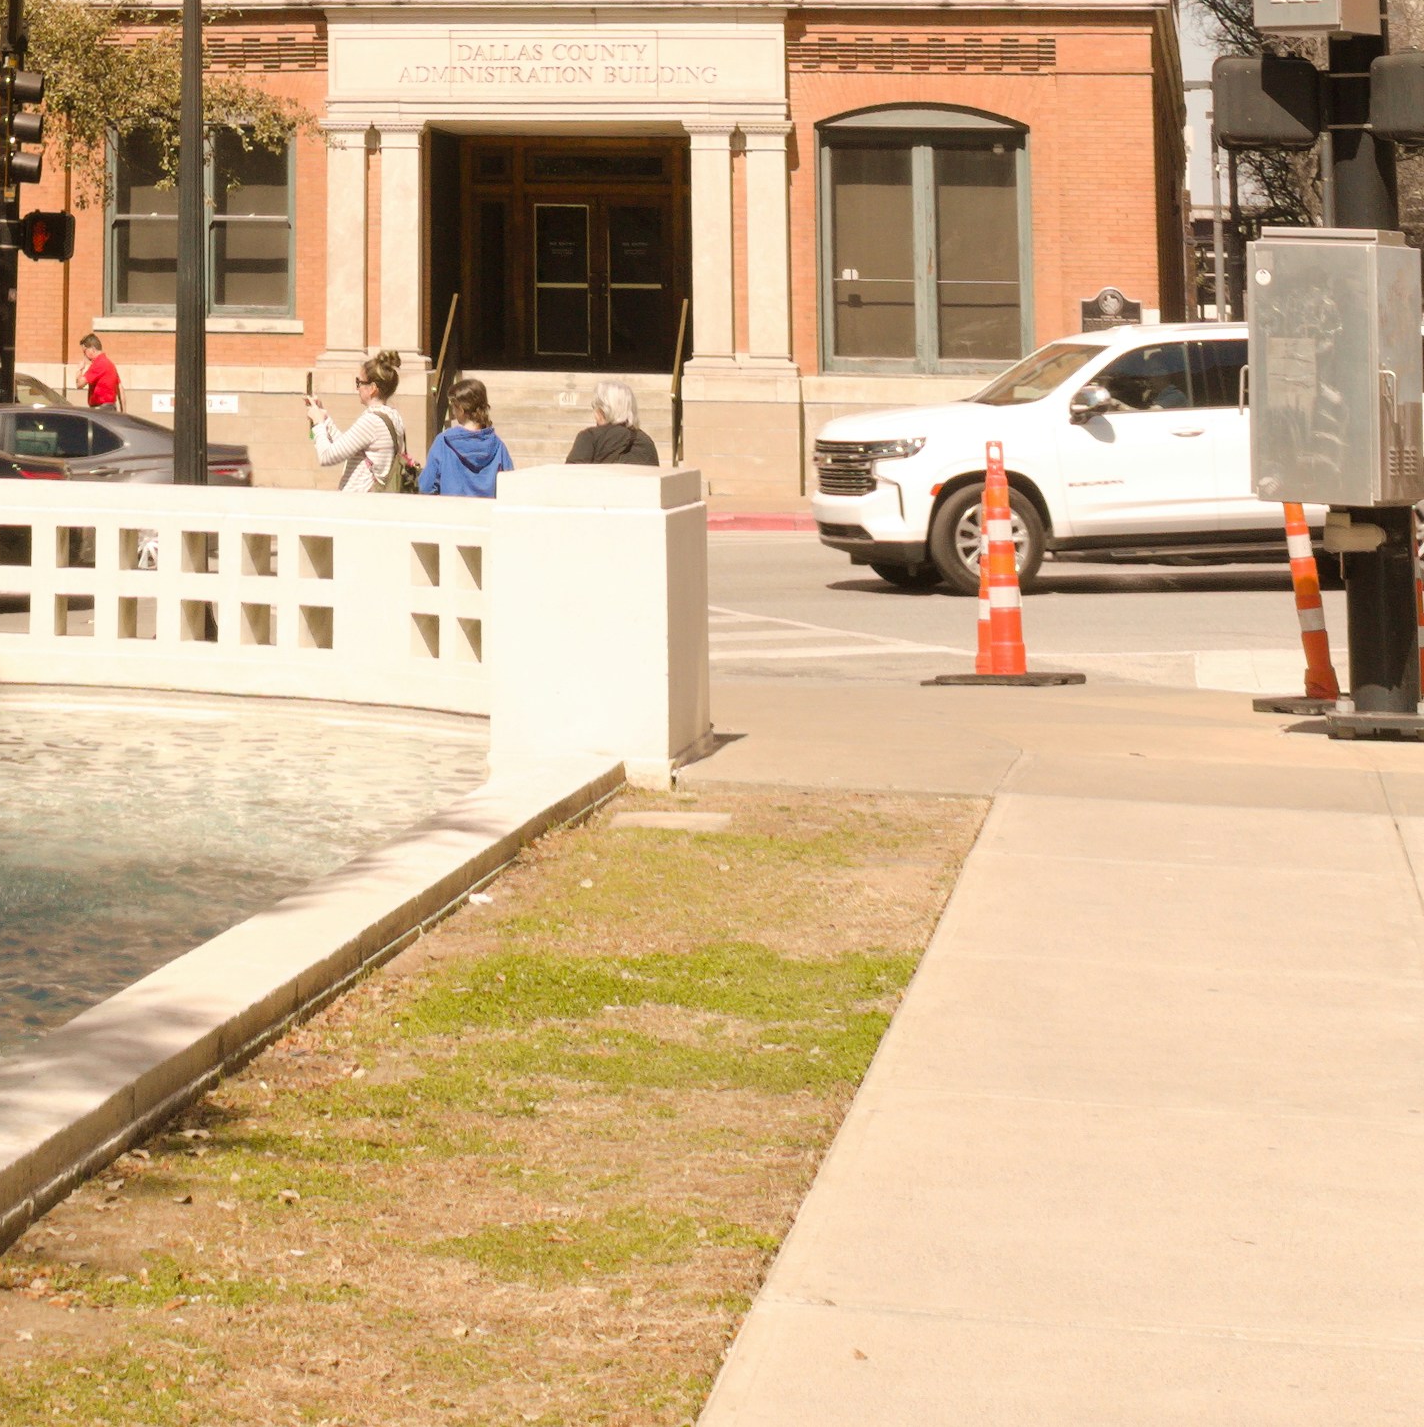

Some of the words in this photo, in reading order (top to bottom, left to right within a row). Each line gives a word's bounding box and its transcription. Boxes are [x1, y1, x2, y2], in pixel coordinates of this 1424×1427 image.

[456, 43, 544, 62] DALLAS
[551, 43, 649, 62] COUNTY
[398, 65, 594, 84] ADMINISTRATION
[603, 65, 719, 85] BUILDING
